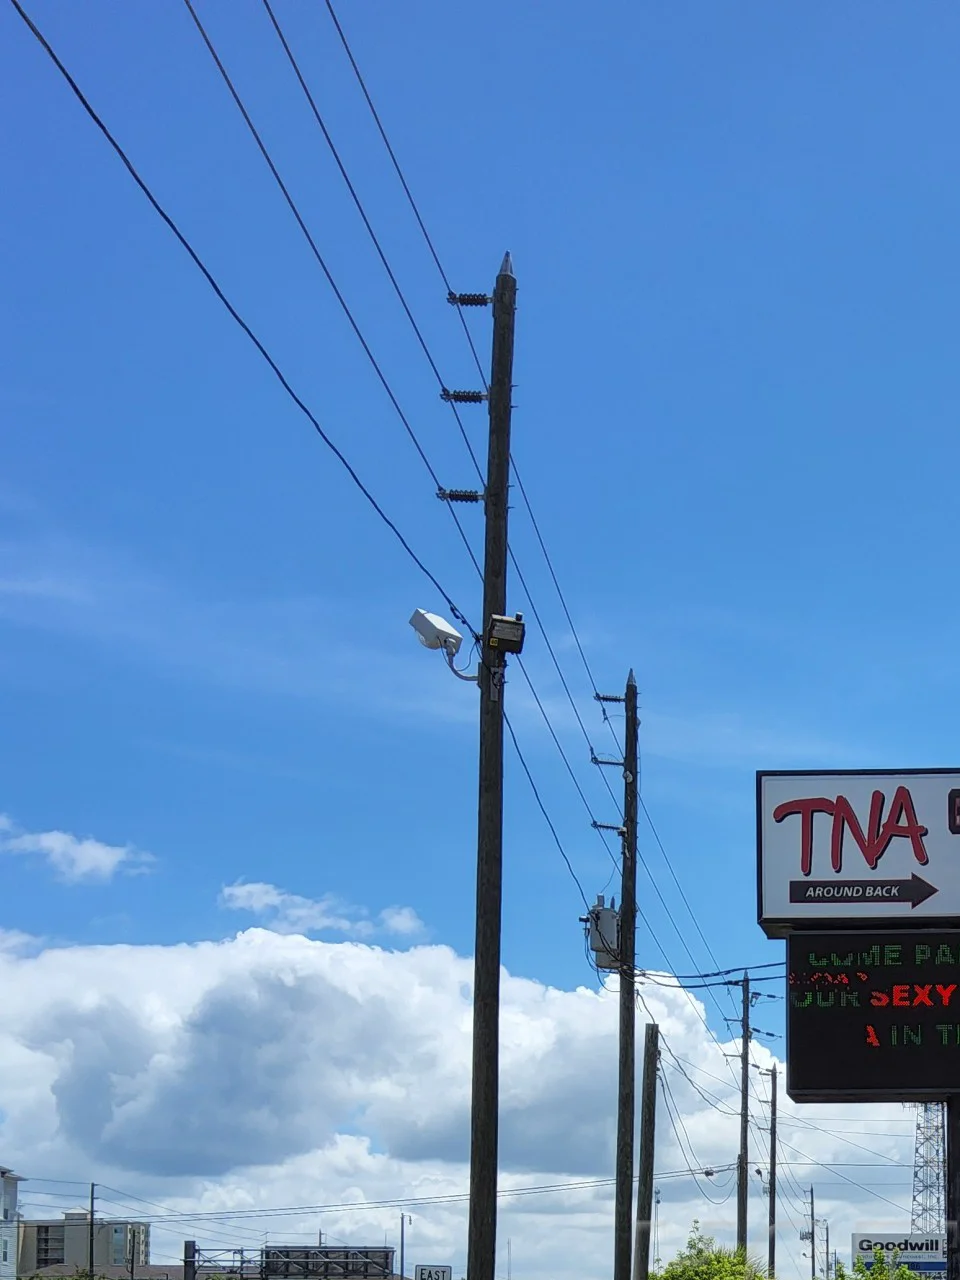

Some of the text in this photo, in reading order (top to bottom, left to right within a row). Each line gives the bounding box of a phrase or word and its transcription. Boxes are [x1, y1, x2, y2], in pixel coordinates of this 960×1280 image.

[773, 785, 929, 876] TNA
[805, 886, 900, 898] AROUND BACK
[870, 984, 957, 1007] SEXY
[891, 1024, 921, 1045] IN
[858, 1239, 939, 1251] Goodwill
[420, 1268, 447, 1280] EAST
